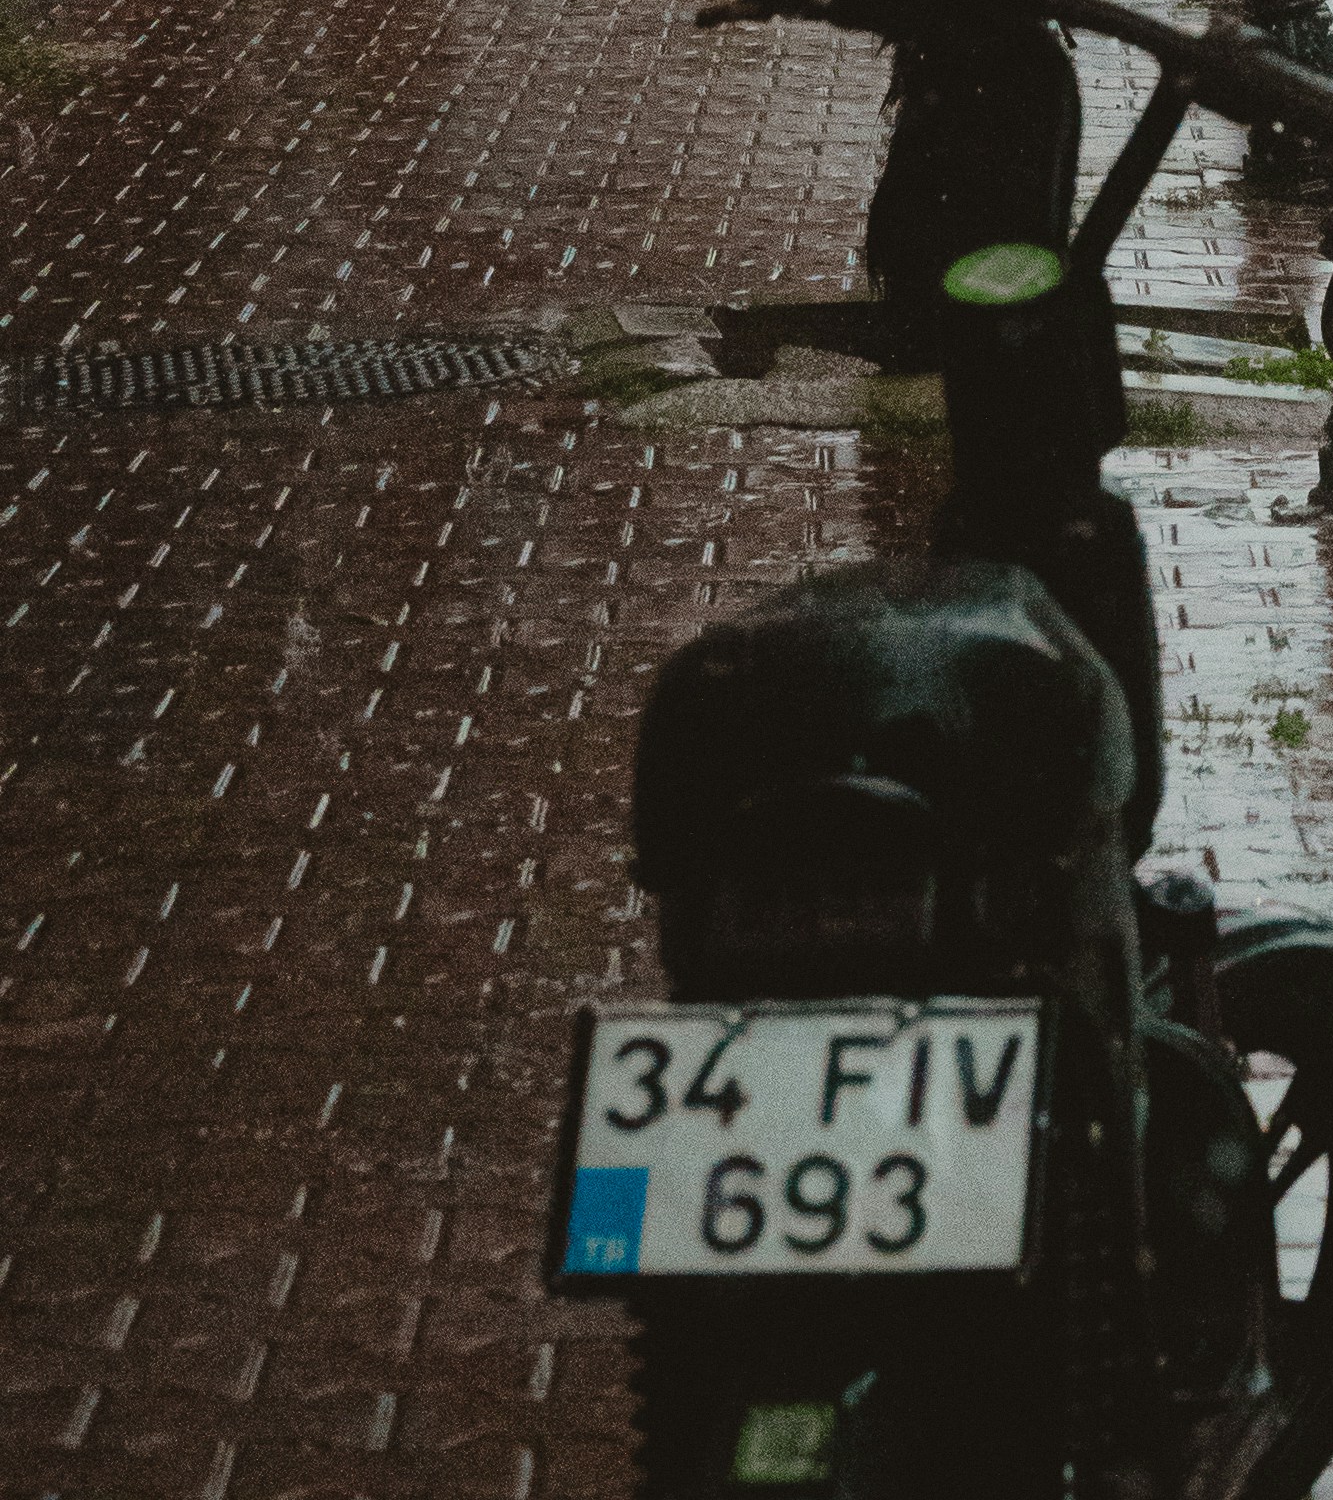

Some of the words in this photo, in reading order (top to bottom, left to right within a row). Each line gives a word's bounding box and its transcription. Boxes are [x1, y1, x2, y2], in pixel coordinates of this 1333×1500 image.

[606, 1032, 747, 1129] 34
[819, 1035, 1021, 1127] FIV
[702, 1155, 928, 1253] 693
